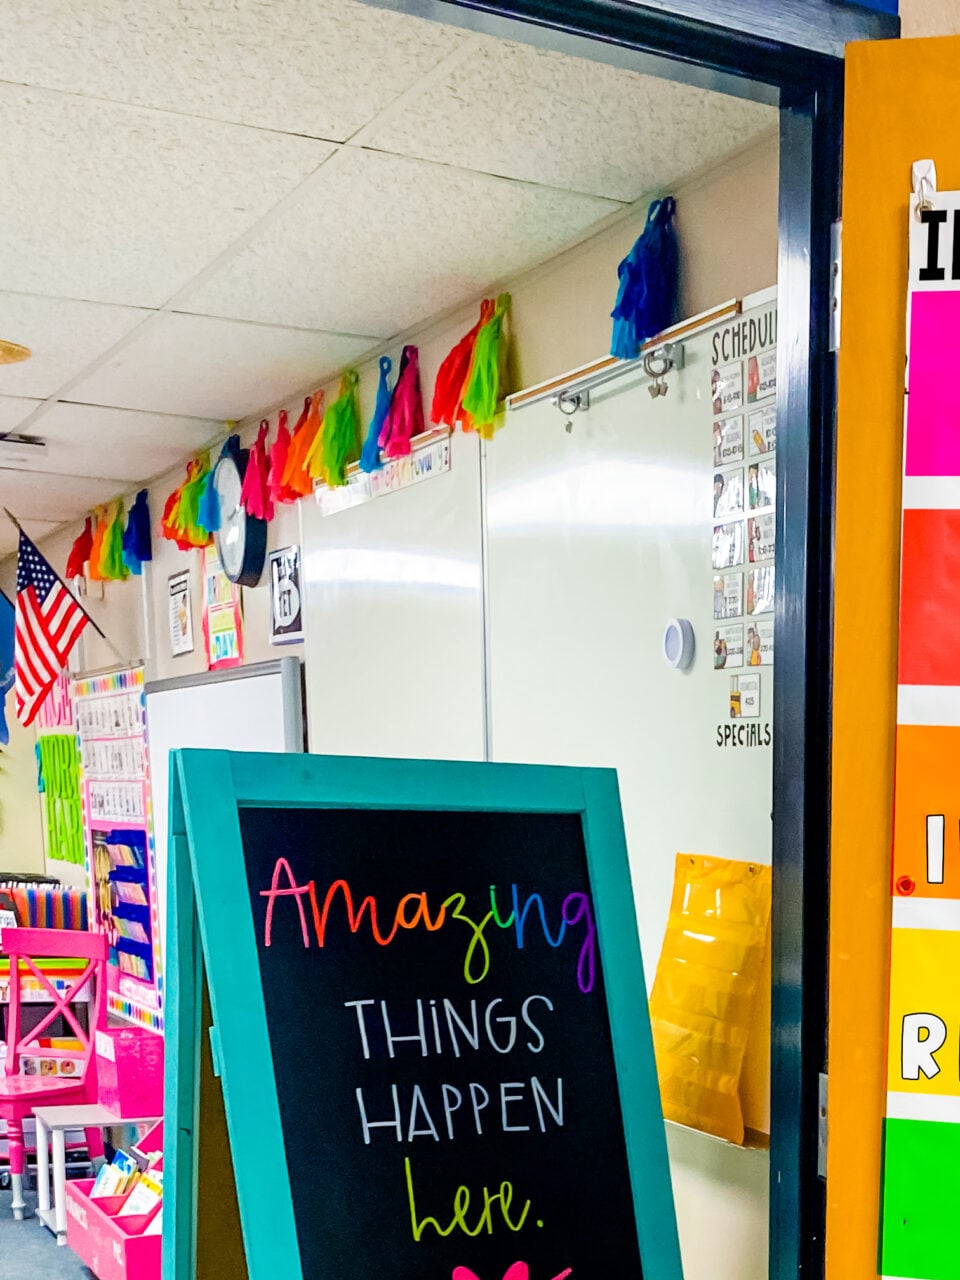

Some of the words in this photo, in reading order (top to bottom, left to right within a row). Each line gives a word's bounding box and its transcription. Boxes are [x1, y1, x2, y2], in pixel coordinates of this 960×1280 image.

[259, 856, 597, 993] Amazing
[355, 1077, 564, 1144] HAPPEN
[405, 1157, 545, 1242] here.
